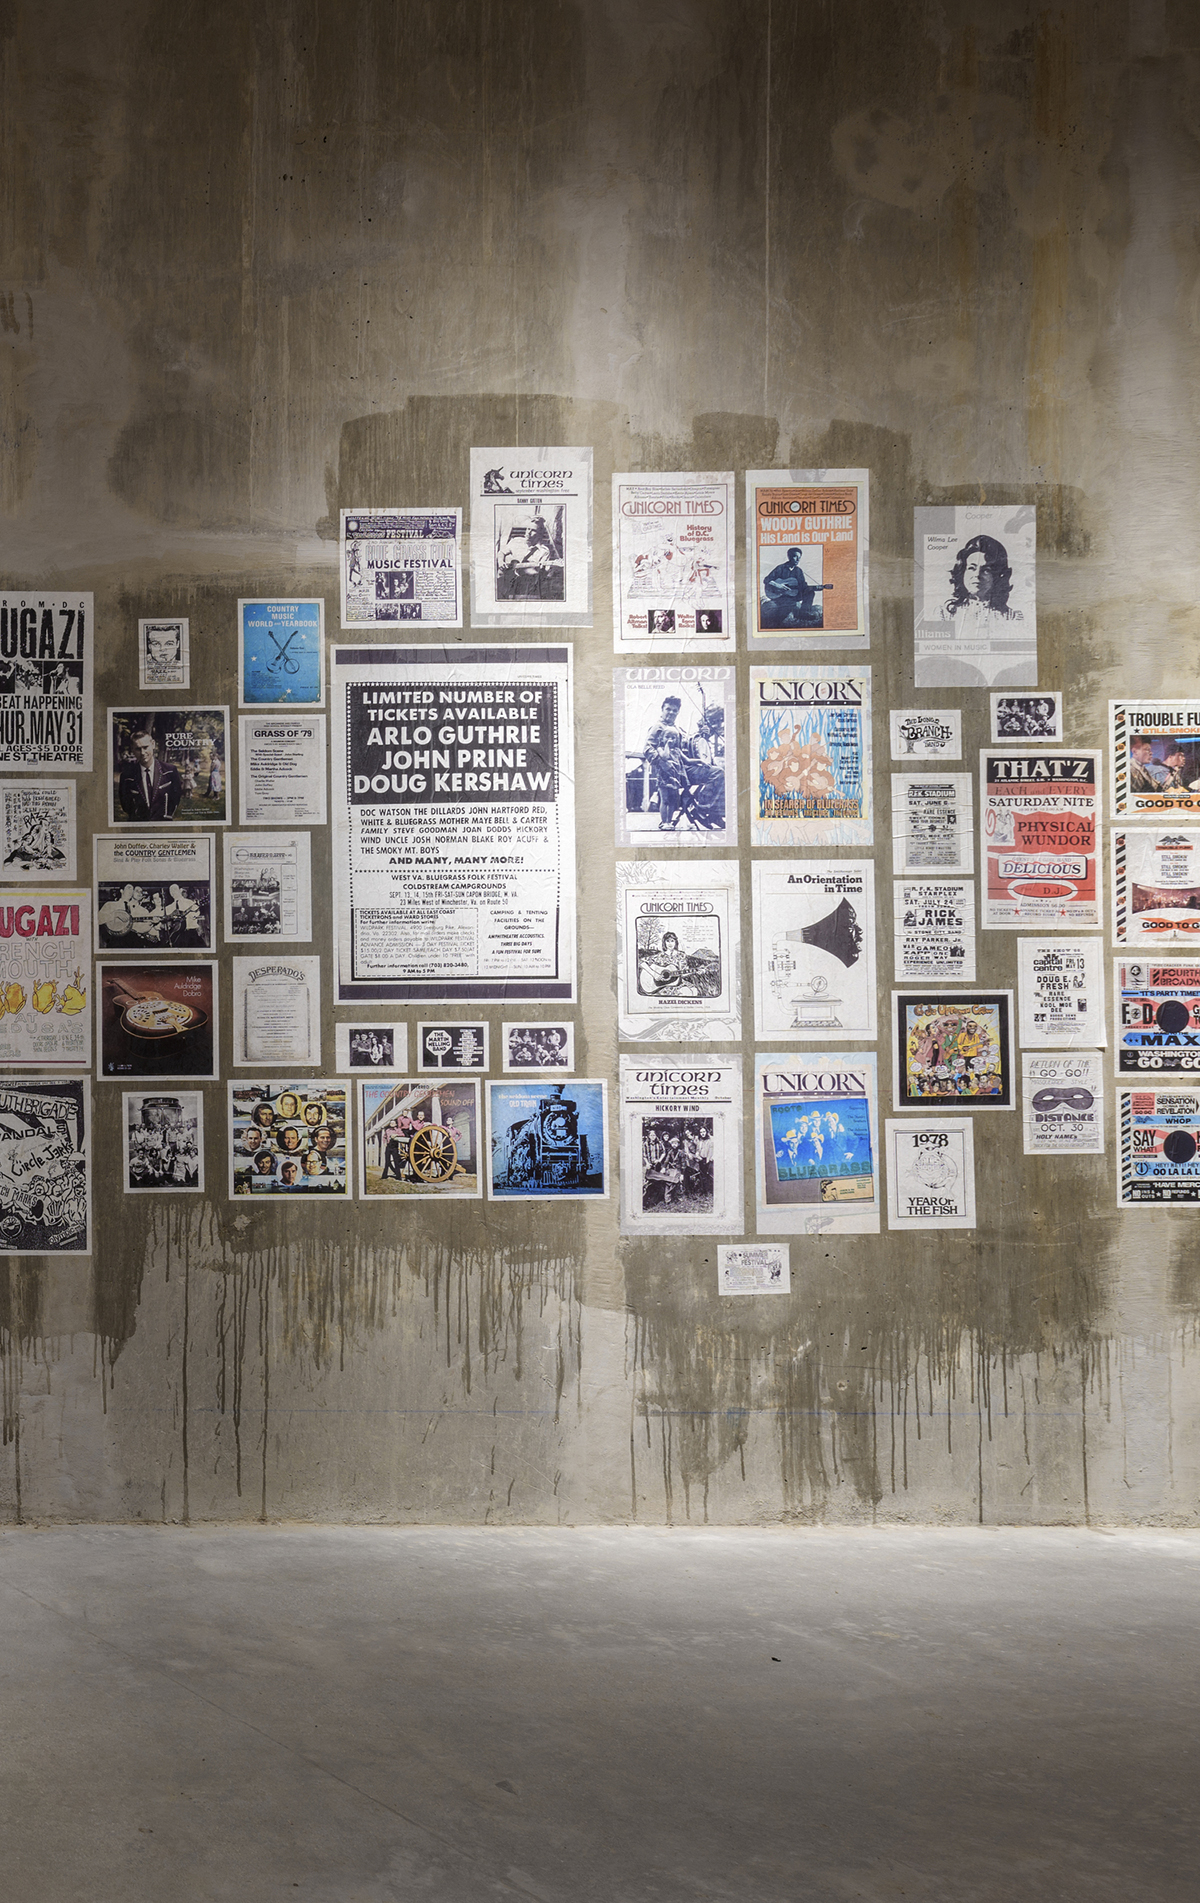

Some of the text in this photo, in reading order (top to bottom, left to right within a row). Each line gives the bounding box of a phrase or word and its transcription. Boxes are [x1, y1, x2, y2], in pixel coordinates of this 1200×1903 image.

[629, 500, 716, 515] UNICORN TIMES
[766, 500, 848, 514] UNICORN TIMES
[760, 516, 852, 531] WOODY GUTHRIE
[679, 535, 714, 543] Bluegrass
[760, 530, 854, 544] His Land is Our Land
[367, 559, 453, 569] MUSIC FESTIVAL
[281, 620, 318, 628] YEARBOOK
[759, 679, 864, 701] UNICORN
[24, 696, 82, 710] HAPPENING
[362, 691, 543, 705] LIMITED NUMBER OF
[367, 708, 538, 721] TICKETS AVAILABLE
[1128, 713, 1183, 726] TROUBLE
[67, 710, 83, 744] 31
[165, 732, 193, 740] PURE
[367, 725, 541, 746] ARLO GUTHRIE
[165, 739, 217, 748] COUNTRY
[31, 753, 83, 761] THEATRE
[382, 749, 527, 770] JOHN PRINE
[993, 760, 1089, 778] THAT'Z
[354, 772, 551, 793] DOUG KERSHAW
[989, 798, 1094, 807] SATURDAY NITE
[1018, 822, 1095, 832] PHYSICAL
[1021, 835, 1091, 845] WUNDOR
[389, 857, 413, 865] AND
[415, 857, 452, 866] MANY,
[490, 856, 524, 864] MORE!
[1003, 863, 1081, 874] DELICIOUS
[787, 875, 863, 884] An Orientation
[825, 884, 863, 893] in Time
[1141, 1035, 1199, 1046] MAX
[762, 1072, 866, 1093] UNICORN
[1036, 1114, 1094, 1122] DISTANCE
[1041, 1124, 1065, 1132] OCT.
[912, 1133, 949, 1149] 1978
[1133, 1130, 1156, 1146] SAY
[908, 1197, 939, 1206] YEAR
[907, 1205, 957, 1215] THE FISH
